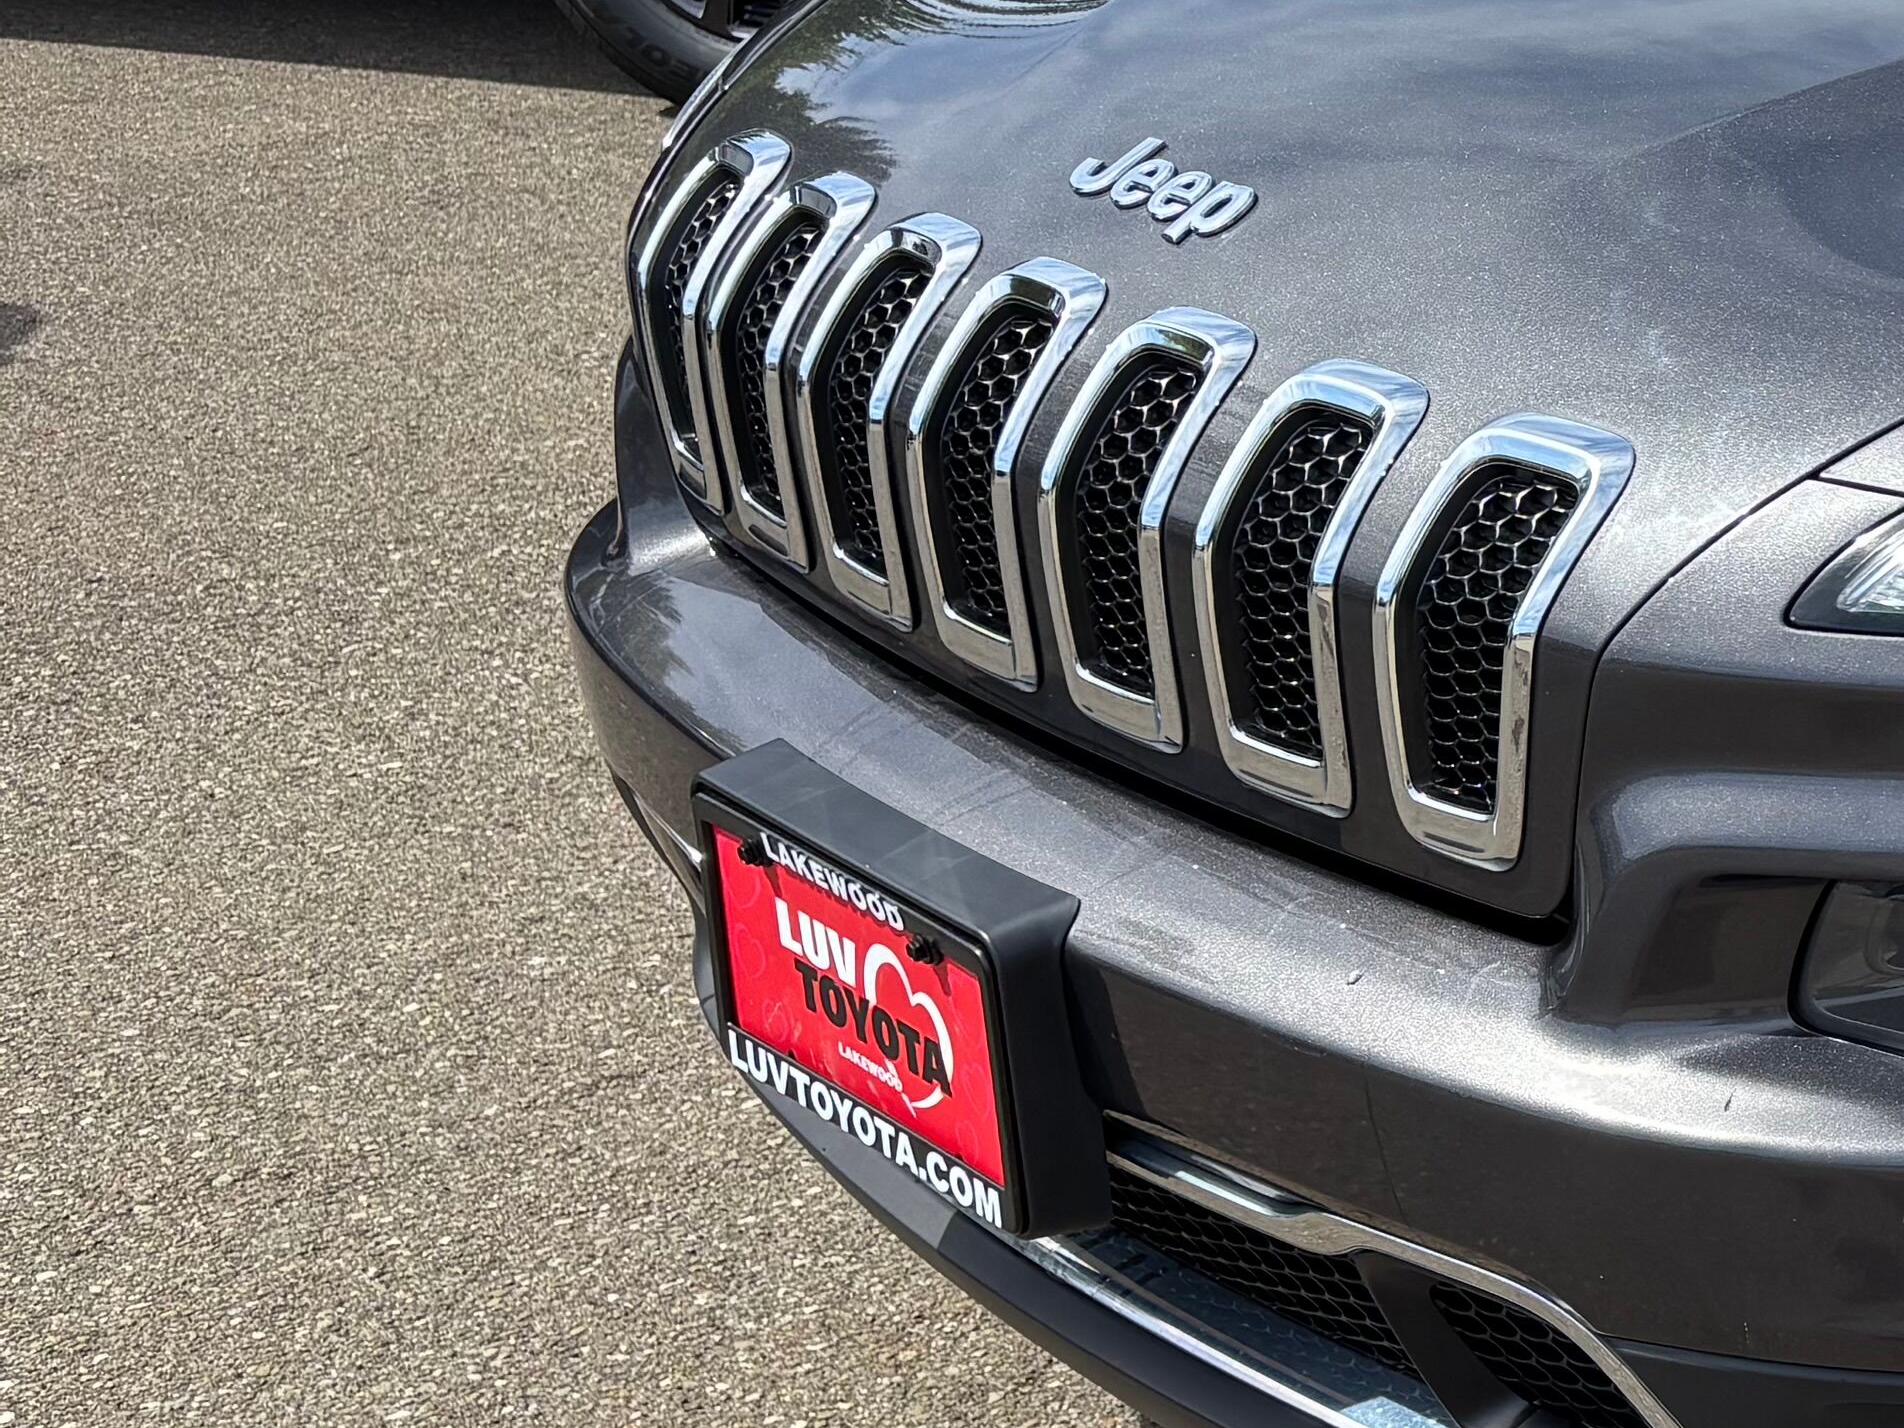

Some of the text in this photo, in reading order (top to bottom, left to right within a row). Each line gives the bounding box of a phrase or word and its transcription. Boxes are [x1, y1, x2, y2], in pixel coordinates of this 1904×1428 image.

[1069, 137, 1258, 246] Jeep
[759, 830, 906, 933] LAKEWOOD
[774, 897, 858, 989] LUV
[794, 957, 953, 1099] TOYOTA
[837, 1039, 905, 1095] LAKEWOOD
[726, 1026, 1004, 1229] LUVTOYOTA.COM
